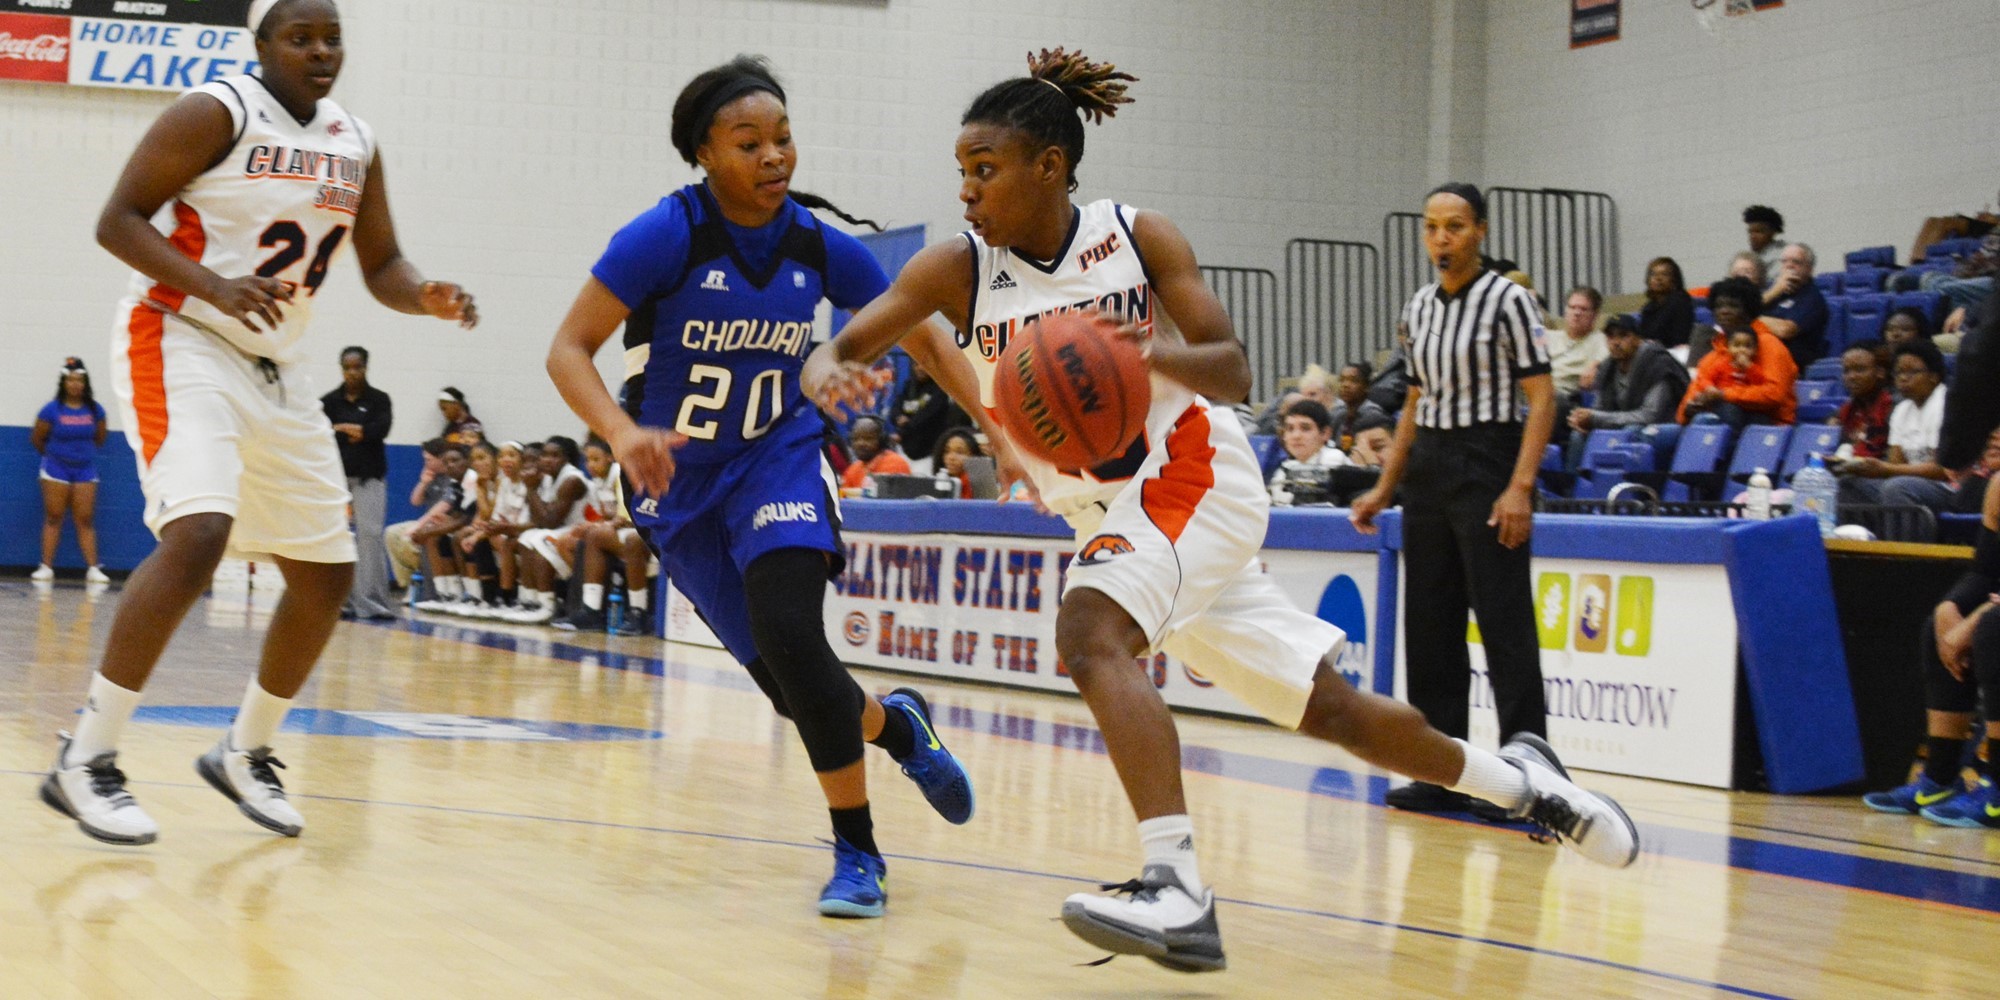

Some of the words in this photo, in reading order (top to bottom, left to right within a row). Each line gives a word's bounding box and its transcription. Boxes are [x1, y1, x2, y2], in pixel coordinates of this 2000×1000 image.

[79, 21, 182, 48] HOME
[196, 29, 241, 50] OF
[90, 51, 264, 88] LAKE
[255, 220, 349, 299] 24
[1076, 232, 1121, 273] PBC
[990, 281, 1017, 291] adidas
[975, 282, 1152, 364] CLON
[675, 364, 783, 441] 20
[753, 501, 818, 531] HAWKS
[953, 547, 1045, 613] STATE
[877, 610, 939, 662] HOME
[952, 629, 979, 665] OF
[992, 633, 1039, 674] THE
[1544, 676, 1678, 729] morrow
